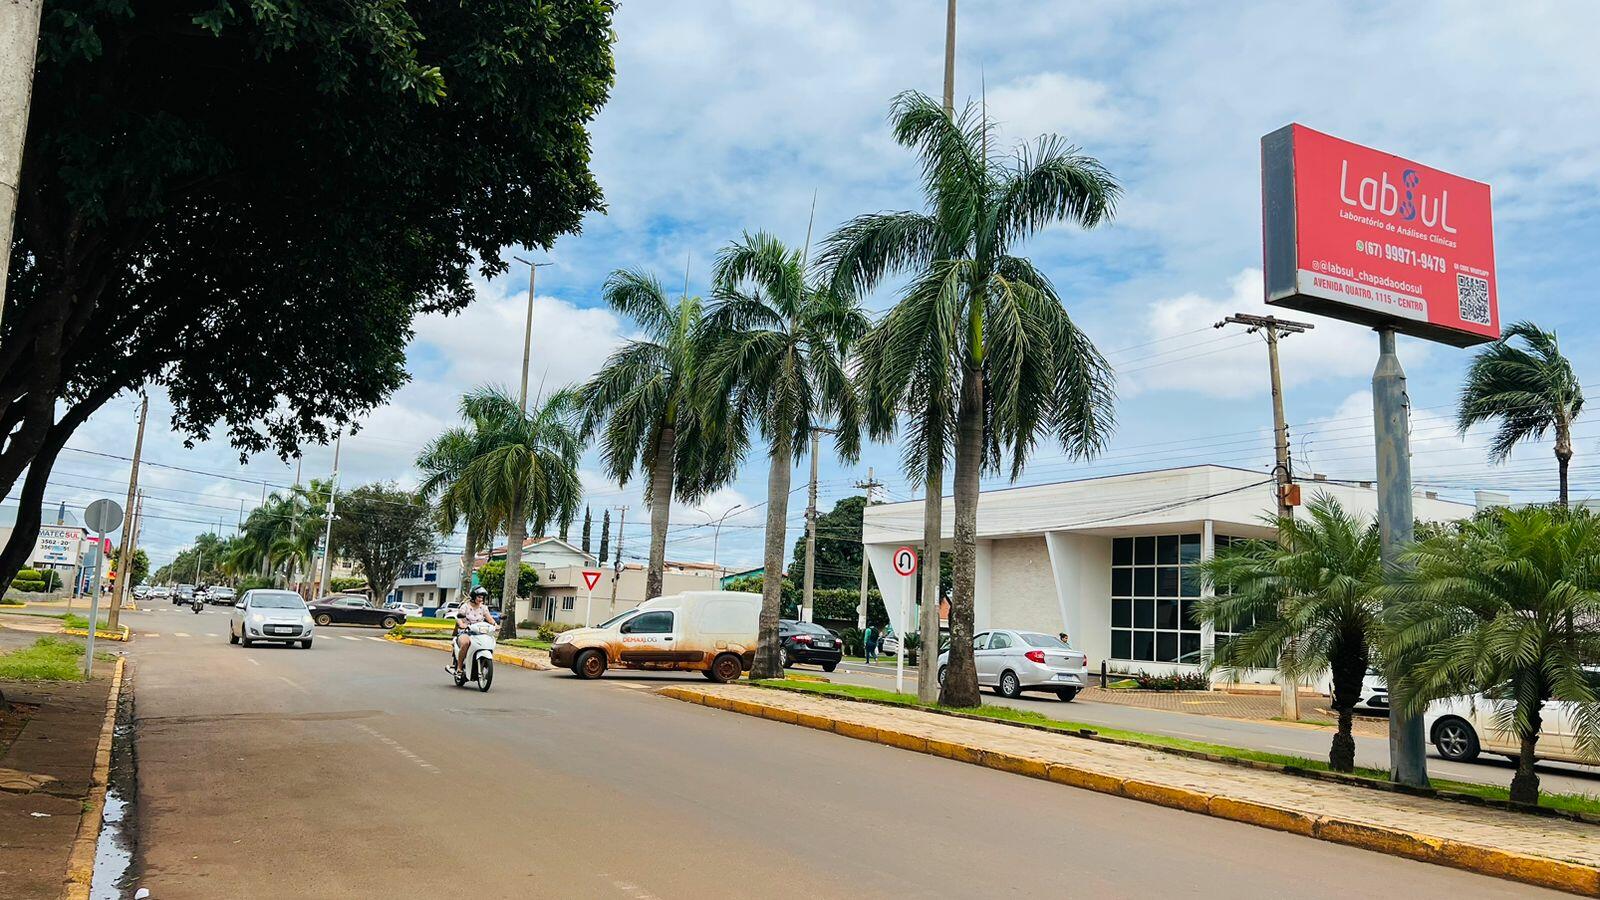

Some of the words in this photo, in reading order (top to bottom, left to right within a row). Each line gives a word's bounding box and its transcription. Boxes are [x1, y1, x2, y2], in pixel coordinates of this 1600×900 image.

[1340, 209, 1384, 229] Laboratório
[1385, 223, 1395, 232] de
[1396, 226, 1428, 241] Análises
[1429, 234, 1457, 248] Clínicas
[1364, 240, 1383, 258] (67)
[1385, 243, 1446, 274] 99971-9479
[1313, 277, 1344, 293] AVENIDA
[1345, 284, 1374, 301] QUATRO,
[1375, 292, 1392, 304] 1115
[1398, 298, 1424, 311] CENTRO
[1320, 260, 1423, 294] @labsul_chapadaodosul
